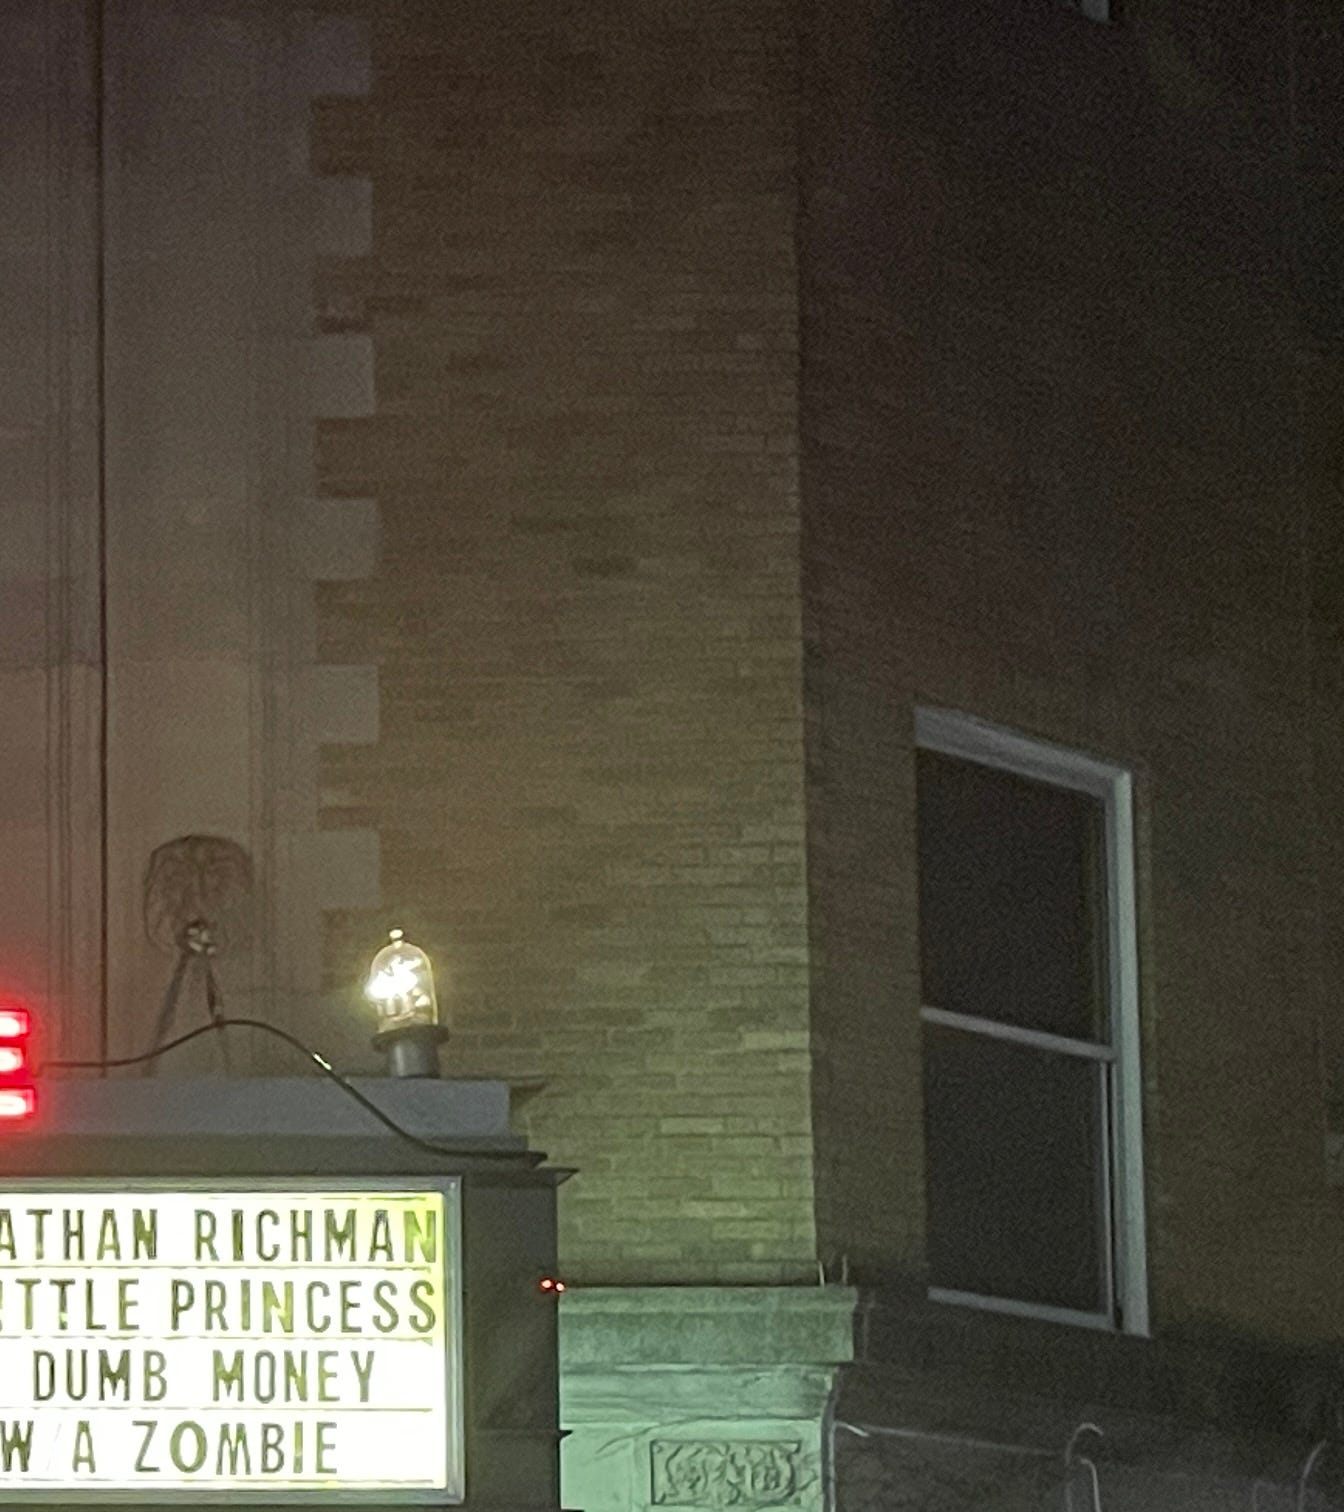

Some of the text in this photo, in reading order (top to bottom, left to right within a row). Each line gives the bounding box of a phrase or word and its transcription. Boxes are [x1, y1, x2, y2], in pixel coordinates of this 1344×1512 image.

[193, 1208, 439, 1264] RICHMAN
[169, 1278, 438, 1334] PRINCESS
[32, 1348, 168, 1402] DUMB
[211, 1349, 376, 1404] MONEY
[71, 1420, 97, 1474] A
[131, 1420, 338, 1476] ZOMBIE
